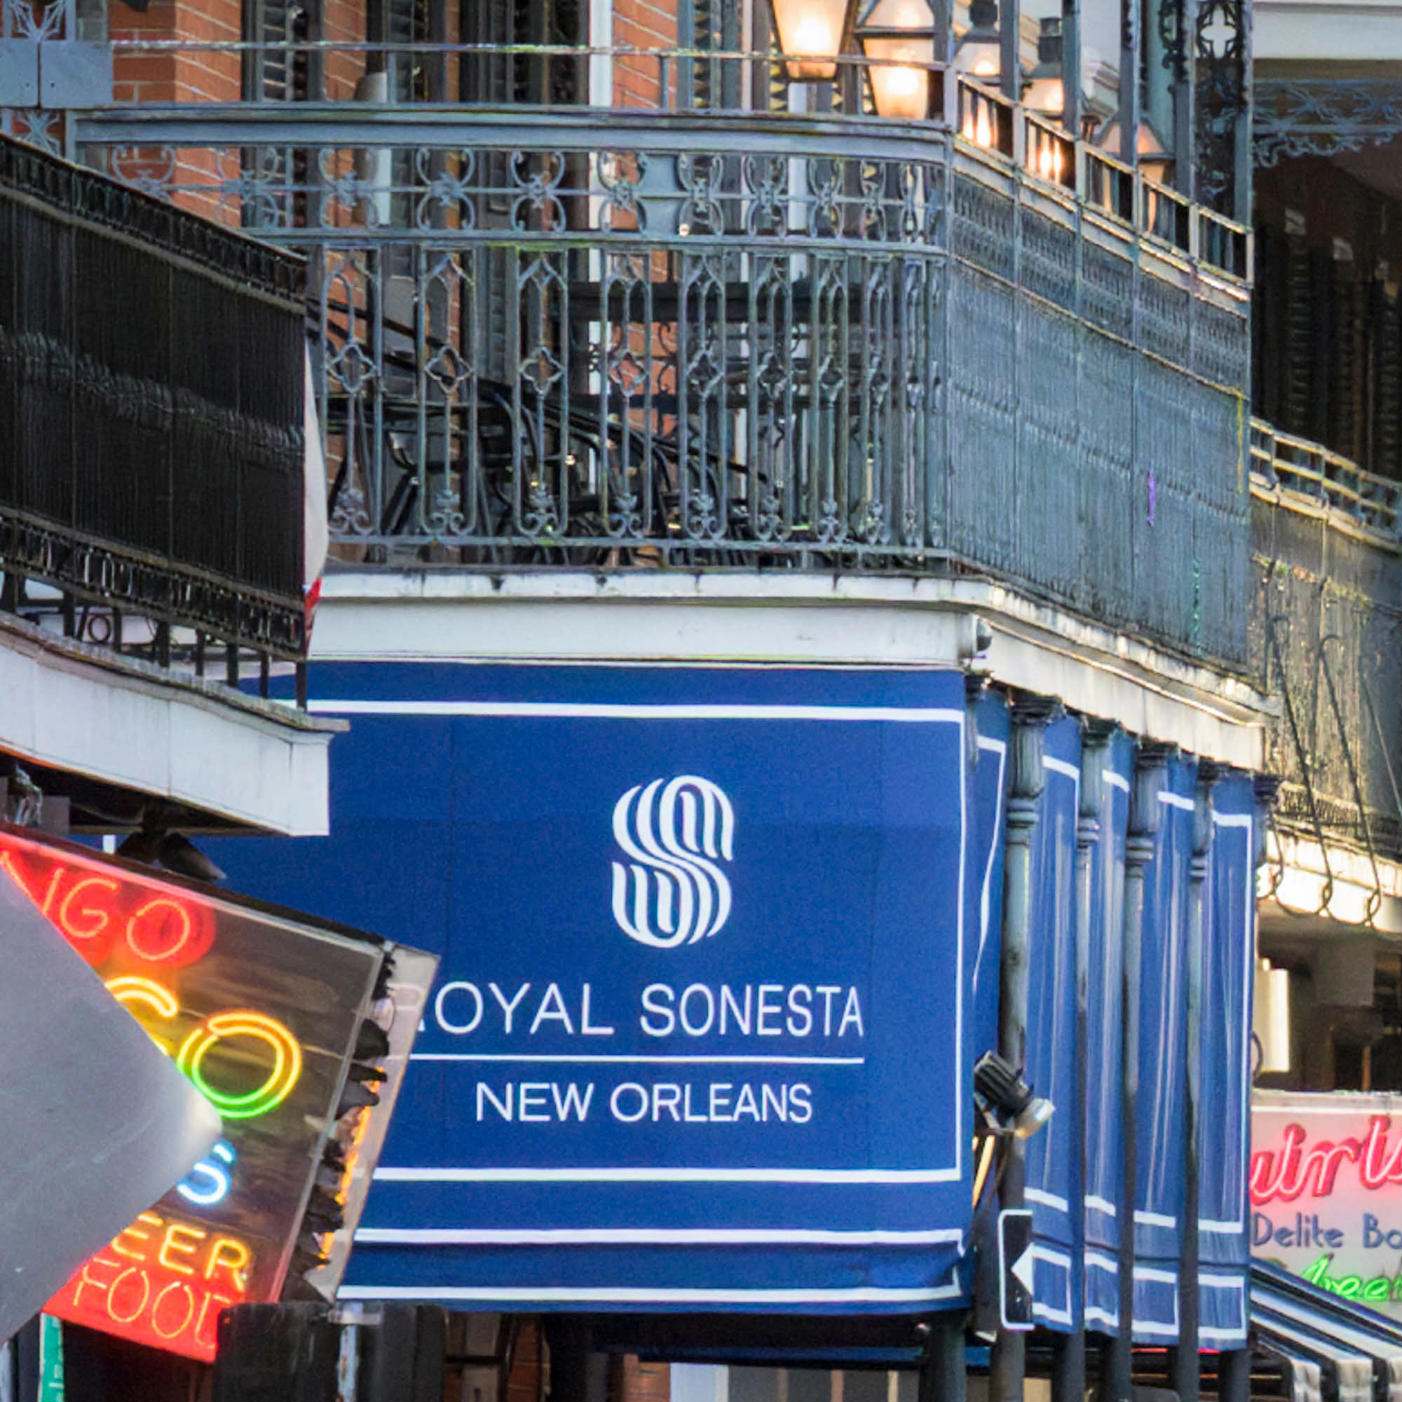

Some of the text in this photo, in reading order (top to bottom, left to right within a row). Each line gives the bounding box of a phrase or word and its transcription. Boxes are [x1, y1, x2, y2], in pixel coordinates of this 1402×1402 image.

[639, 983, 864, 1037] SONESTA
[476, 1082, 813, 1122] NEW ORLEANS
[1252, 1211, 1344, 1249] Delite
